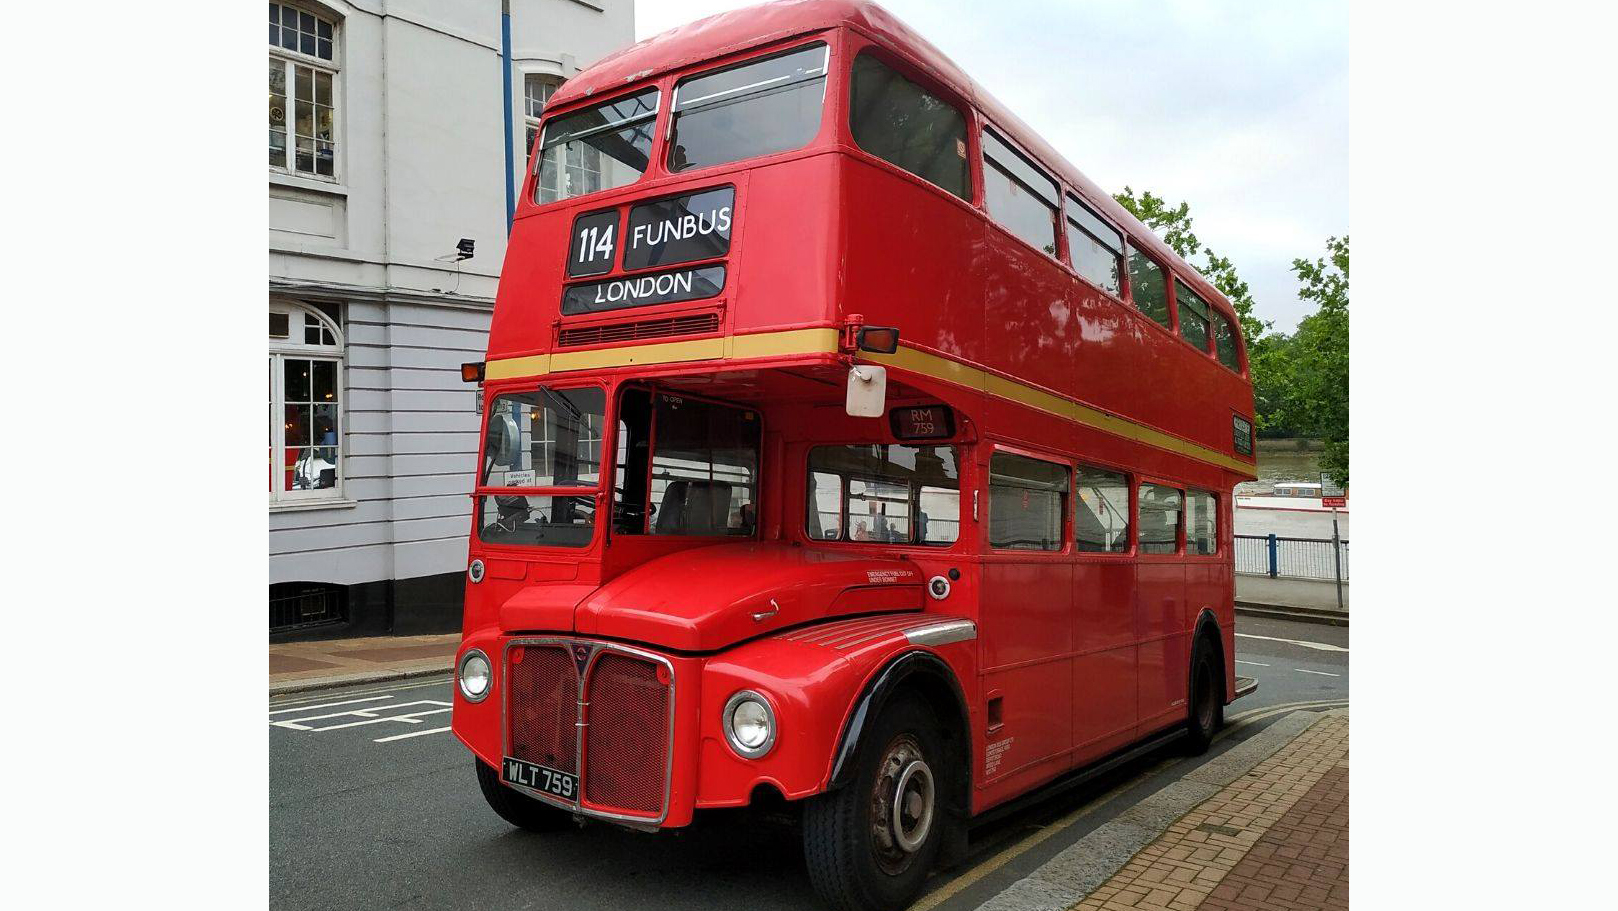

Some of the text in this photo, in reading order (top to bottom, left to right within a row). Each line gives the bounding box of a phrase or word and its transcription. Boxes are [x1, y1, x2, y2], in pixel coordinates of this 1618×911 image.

[579, 224, 614, 263] 114
[633, 206, 731, 249] FUNBUS
[594, 271, 693, 304] LONDON
[911, 409, 933, 422] RM
[913, 422, 935, 434] 759
[509, 761, 573, 797] WLT 759
